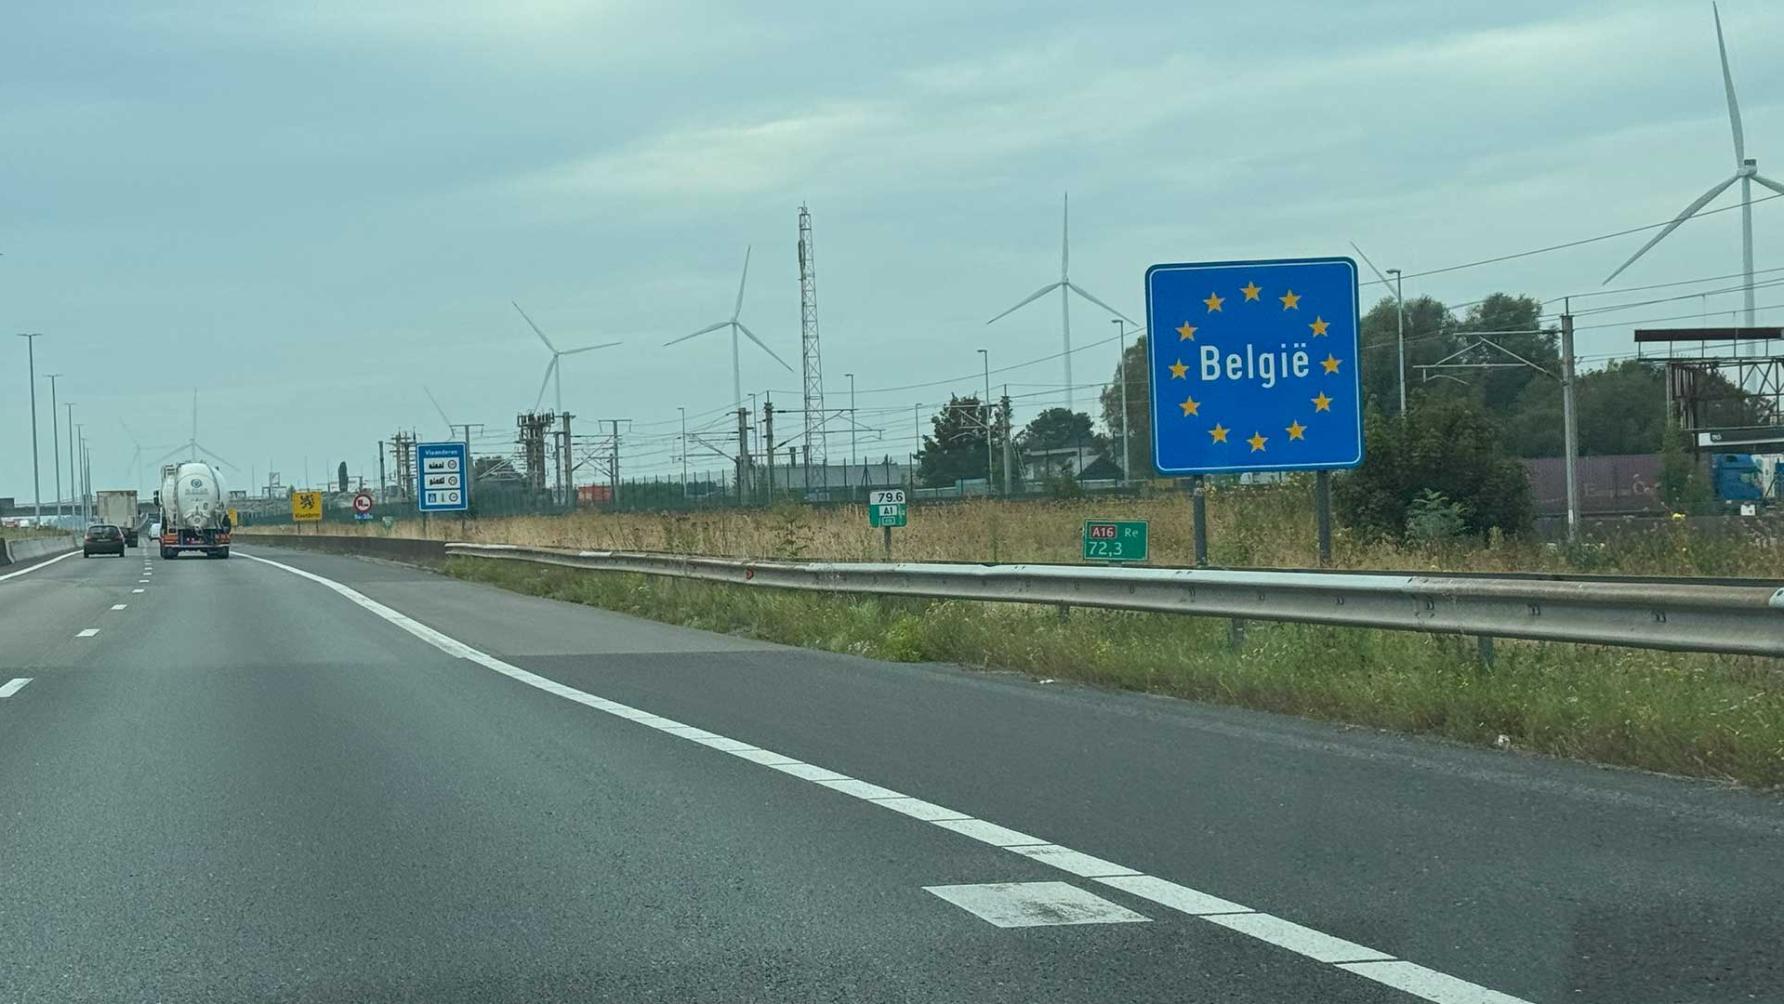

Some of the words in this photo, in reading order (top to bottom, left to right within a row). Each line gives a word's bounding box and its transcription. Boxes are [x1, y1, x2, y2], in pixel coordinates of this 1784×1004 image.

[1200, 342, 1309, 389] België
[883, 506, 893, 515] A1
[1092, 527, 1114, 538] A16
[1124, 527, 1139, 538] Re
[1088, 541, 1122, 557] 72,3
